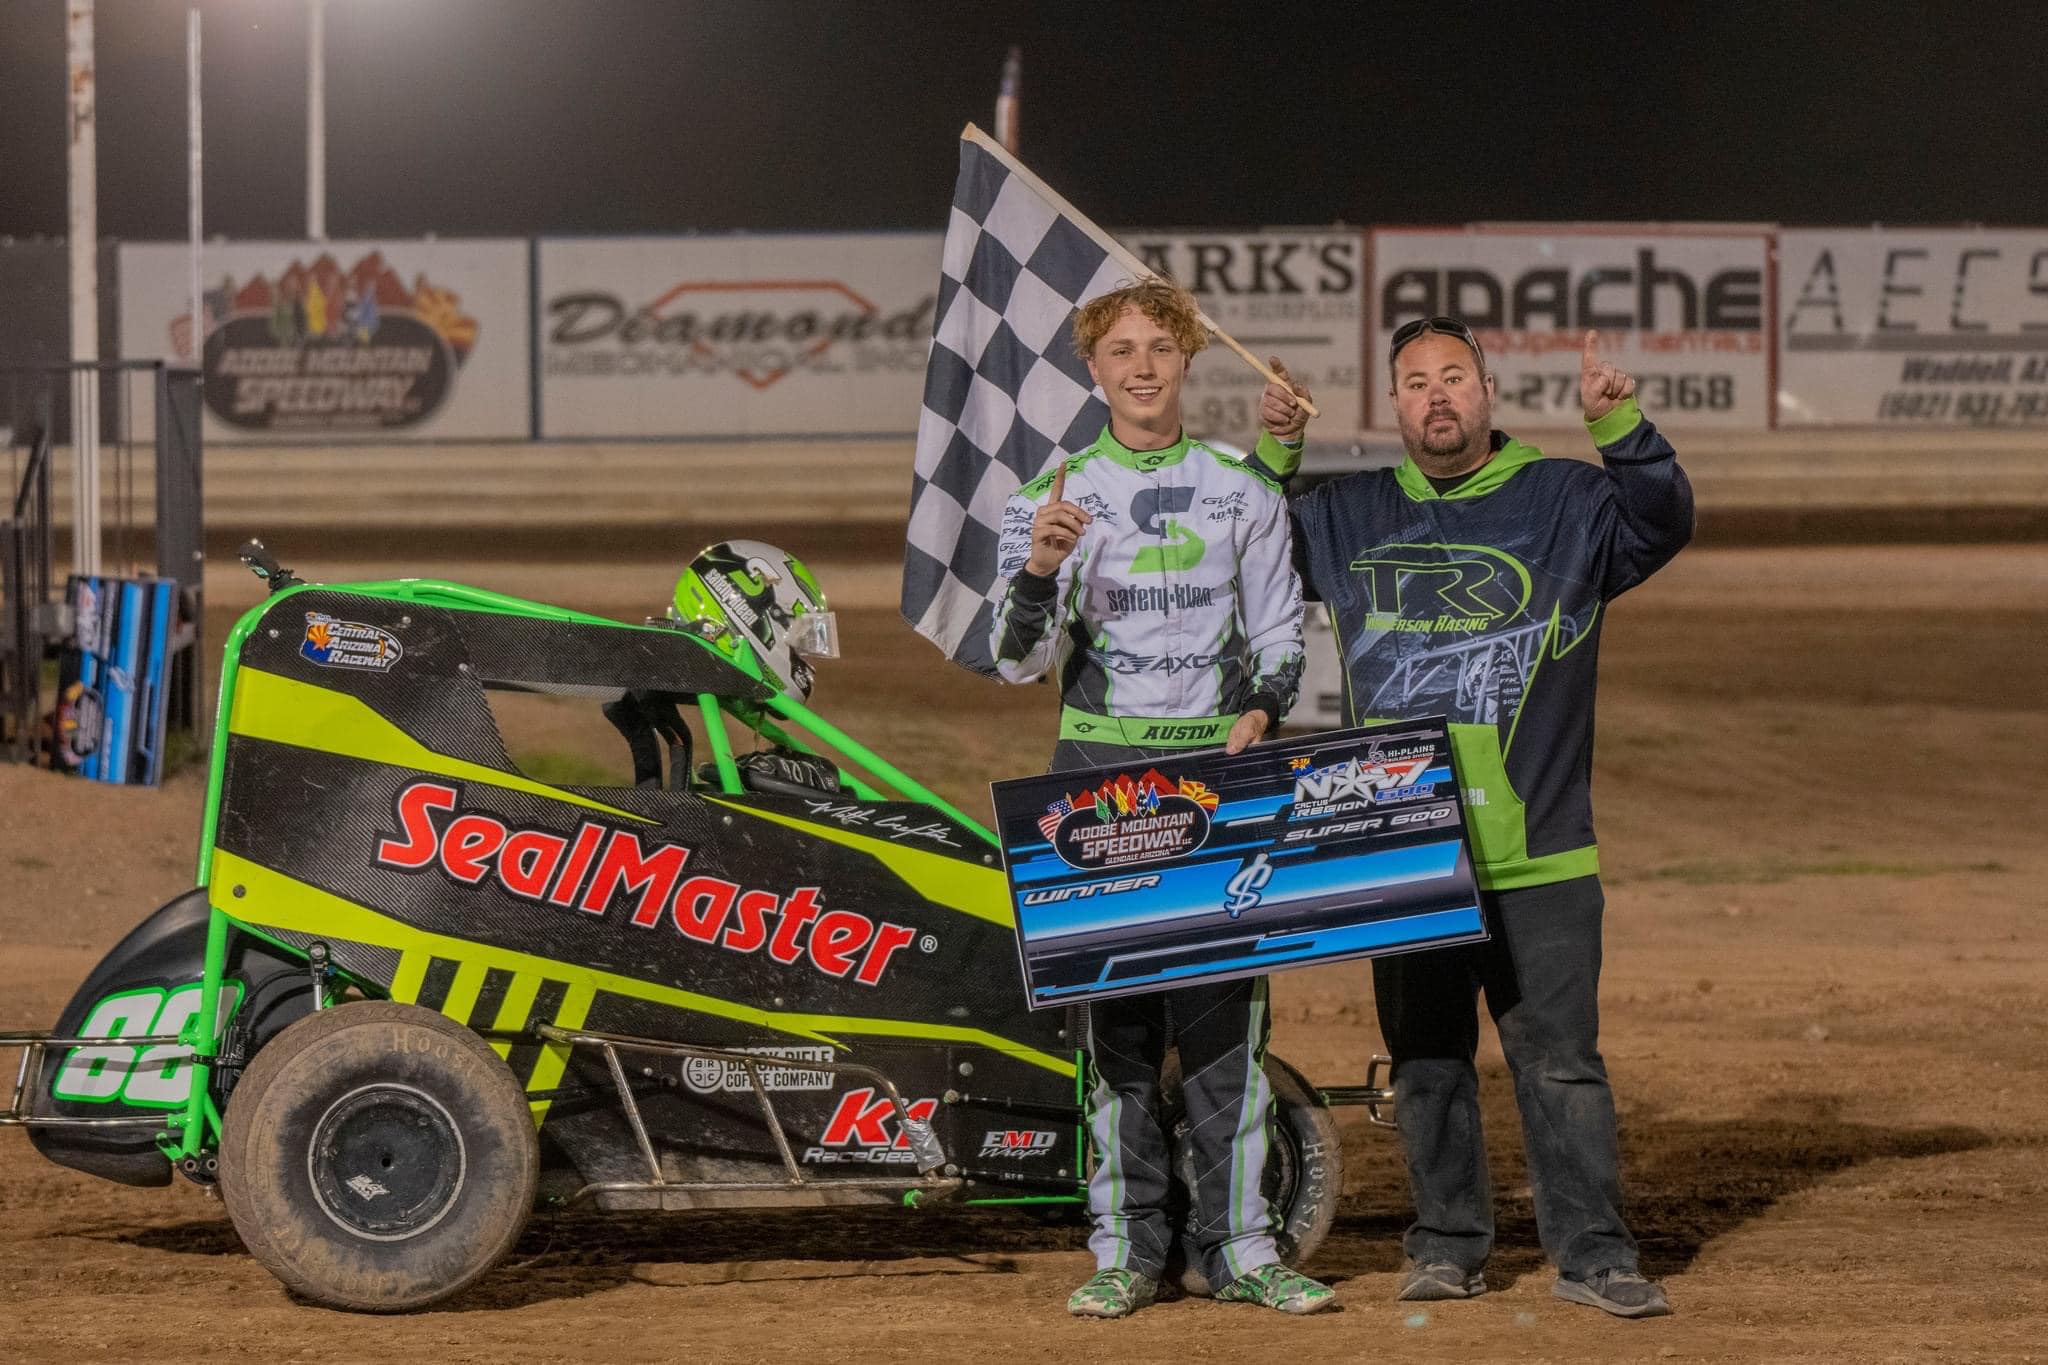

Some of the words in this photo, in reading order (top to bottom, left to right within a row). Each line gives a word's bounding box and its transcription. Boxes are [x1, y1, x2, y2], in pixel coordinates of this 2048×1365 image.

[1140, 243, 1356, 295] ARK'S
[1142, 723, 1220, 740] AUSTIN
[1387, 744, 1436, 758] HI-PLAINS
[1294, 799, 1329, 810] CACTUS
[1296, 799, 1370, 817] REGION
[1068, 822, 1119, 842] ADOBE
[1120, 811, 1195, 835] MOUNTAIN
[1283, 817, 1384, 842] SUPER
[1389, 806, 1452, 827] 600
[1081, 827, 1188, 860] SPEEDWAY
[1104, 852, 1139, 865] GLENDALE
[1140, 848, 1171, 860] ARIZONA
[377, 781, 917, 986] SealMaster
[1023, 874, 1161, 906] WINNER
[774, 1072, 831, 1087] COMPANY
[982, 1130, 1057, 1149] EMD
[802, 1147, 918, 1164] RaceGea
